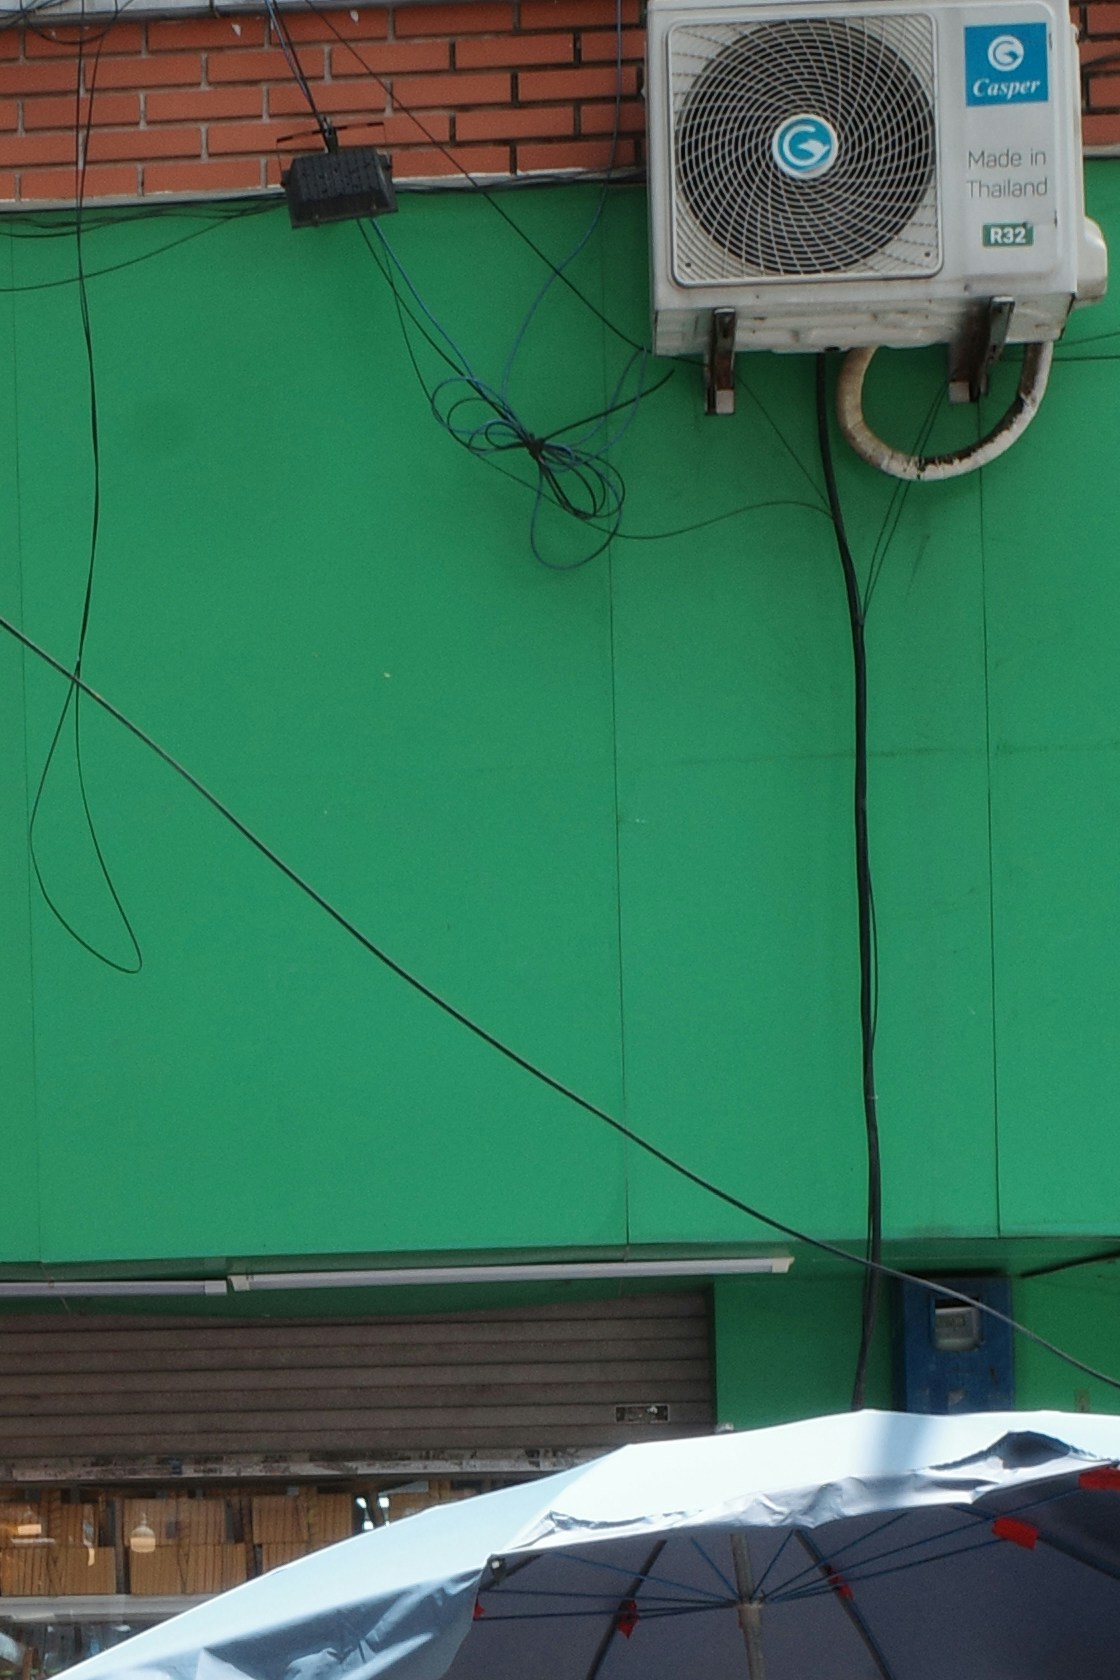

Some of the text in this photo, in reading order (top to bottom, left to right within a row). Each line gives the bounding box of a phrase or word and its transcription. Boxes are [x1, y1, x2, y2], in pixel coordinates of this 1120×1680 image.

[972, 77, 1041, 99] Casper
[967, 147, 1047, 169] Made in
[966, 177, 1048, 200] Thailand
[988, 227, 1028, 246] R32
